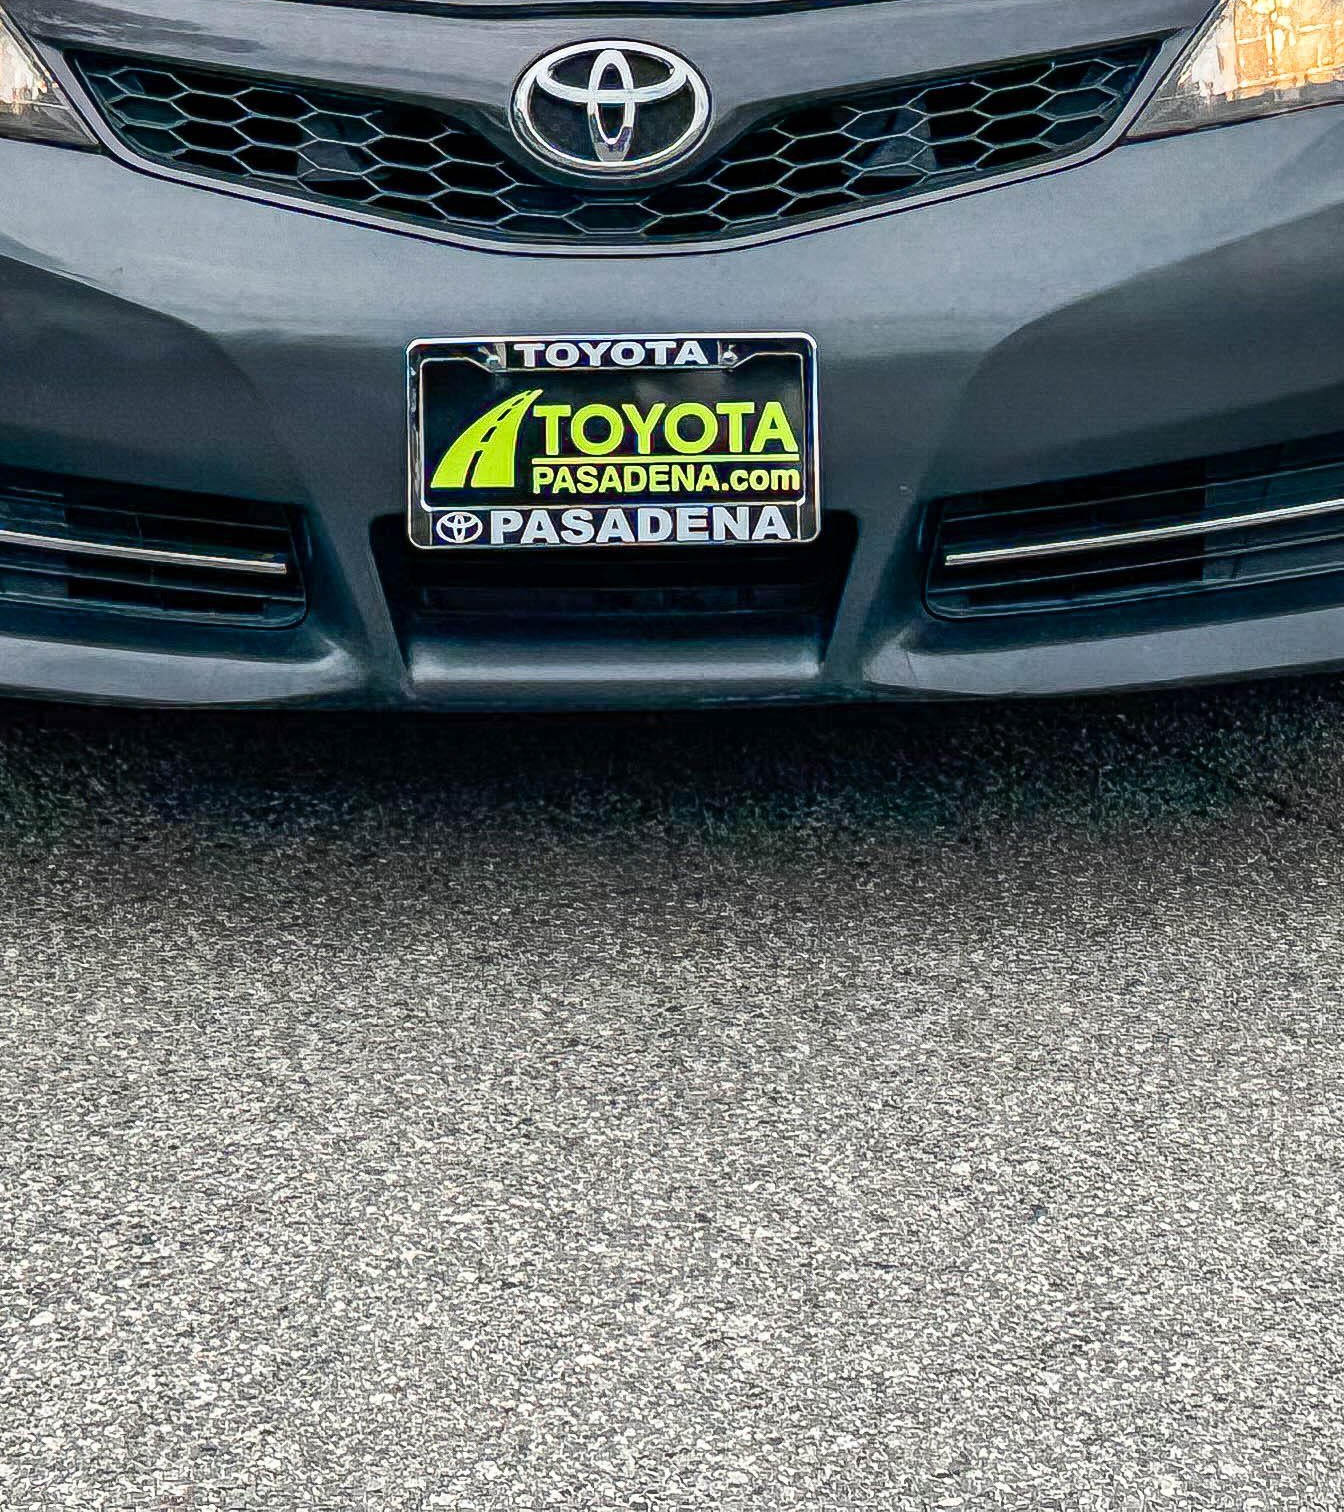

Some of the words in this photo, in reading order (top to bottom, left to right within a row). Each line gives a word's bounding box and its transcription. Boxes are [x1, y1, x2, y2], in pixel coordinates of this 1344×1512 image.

[514, 341, 708, 367] TOYOTA
[532, 401, 799, 455] TOYOTA
[532, 462, 801, 494] PASADENA.com
[490, 505, 792, 545] PASADENA
